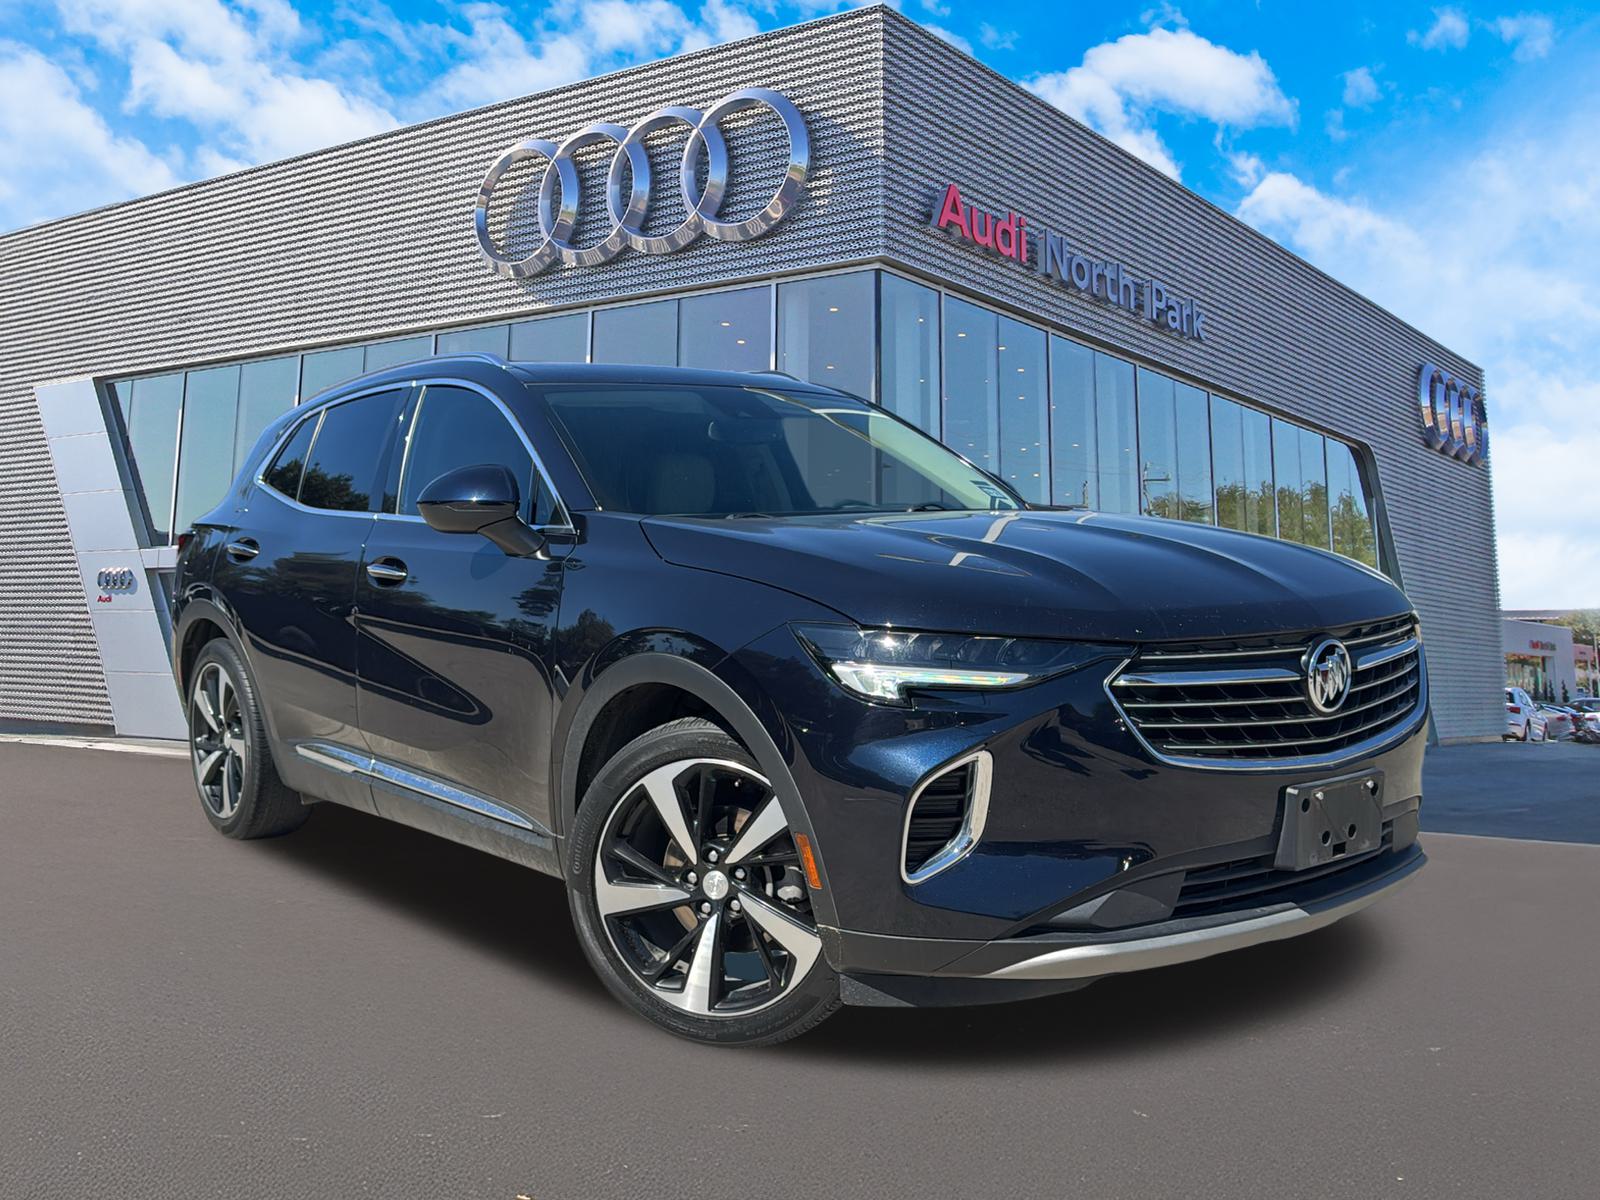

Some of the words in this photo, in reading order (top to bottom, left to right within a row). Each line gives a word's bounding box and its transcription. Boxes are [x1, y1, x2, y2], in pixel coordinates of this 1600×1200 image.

[932, 183, 1028, 263] Audi
[1036, 229, 1137, 311] North
[1143, 278, 1208, 341] Park
[97, 595, 112, 603] Audi
